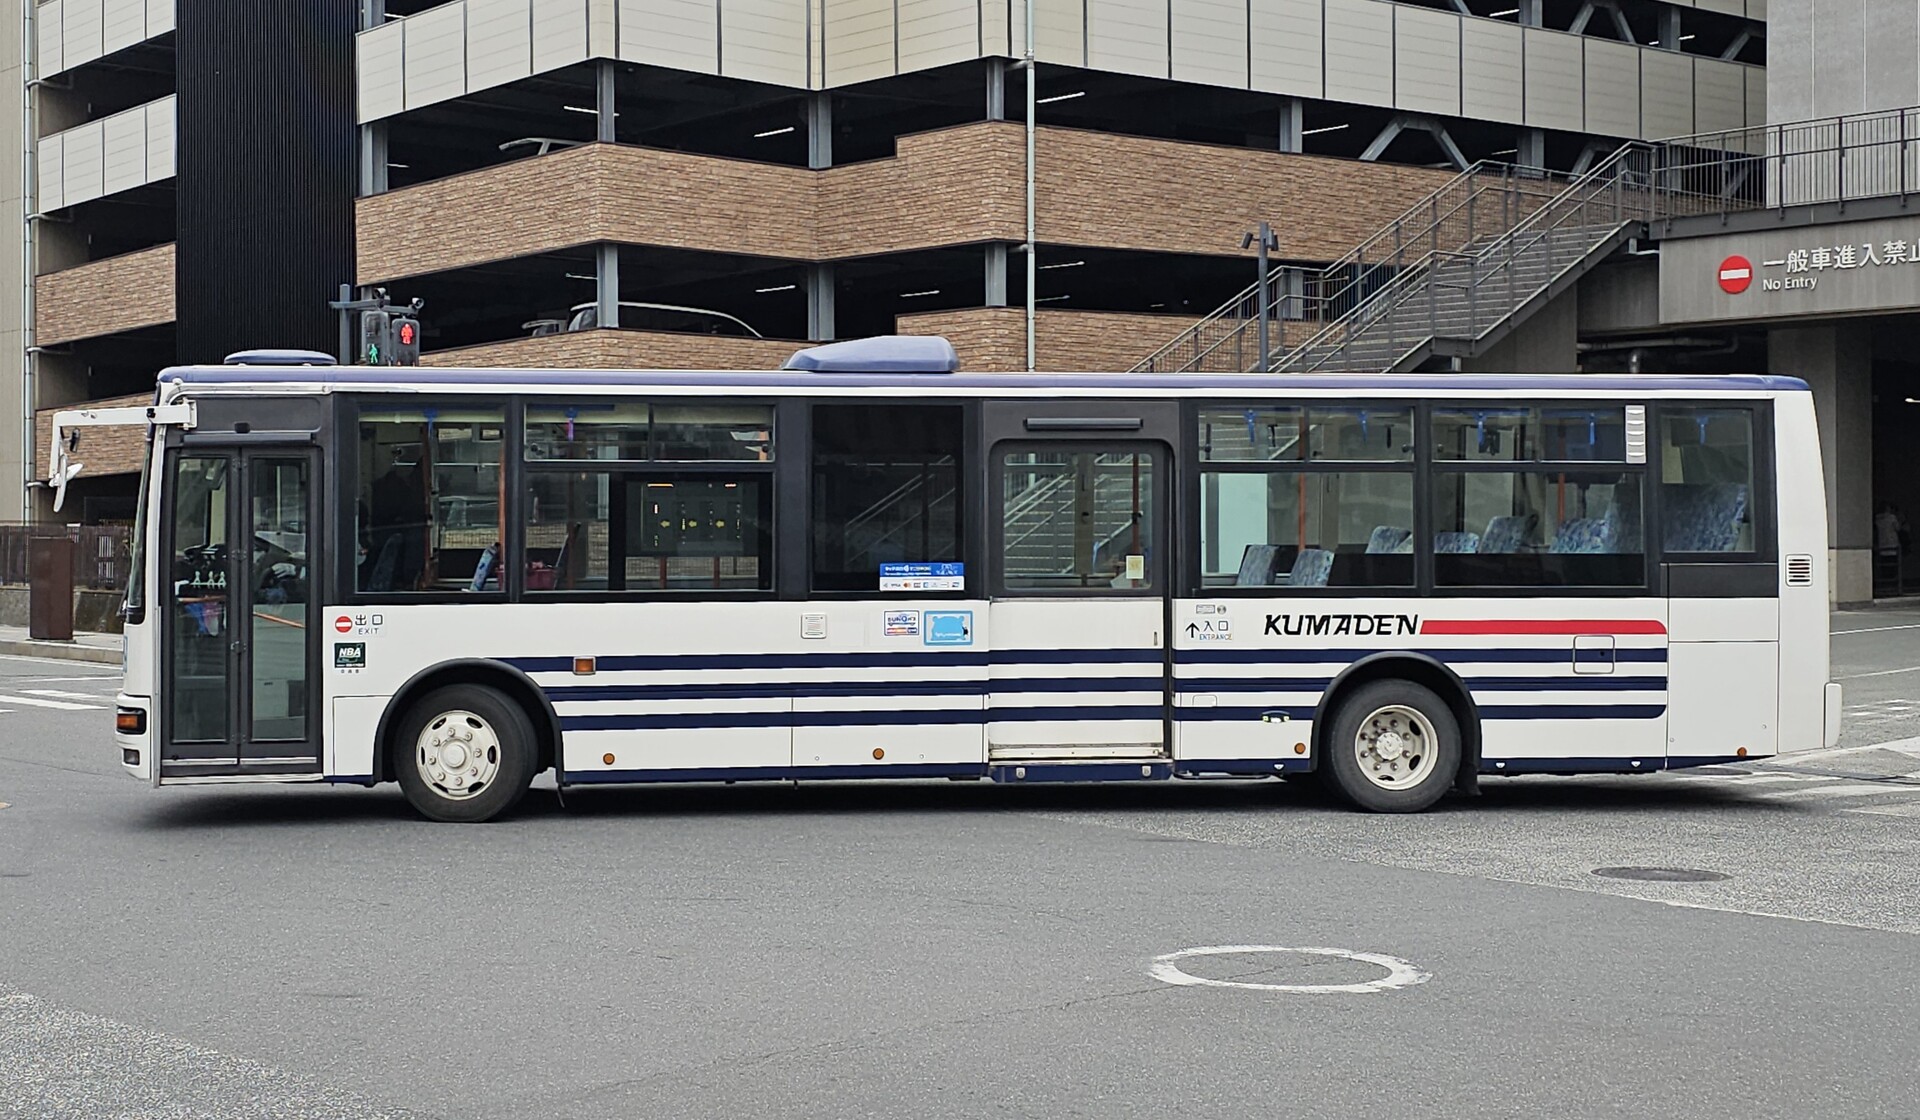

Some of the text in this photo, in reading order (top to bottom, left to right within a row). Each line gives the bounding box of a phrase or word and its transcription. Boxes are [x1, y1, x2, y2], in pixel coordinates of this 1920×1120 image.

[1763, 276, 1818, 291] No Entry
[355, 614, 383, 626] 出口
[1204, 620, 1229, 632] 入口
[1264, 614, 1419, 635] KUMADEN
[339, 647, 361, 658] NBA
